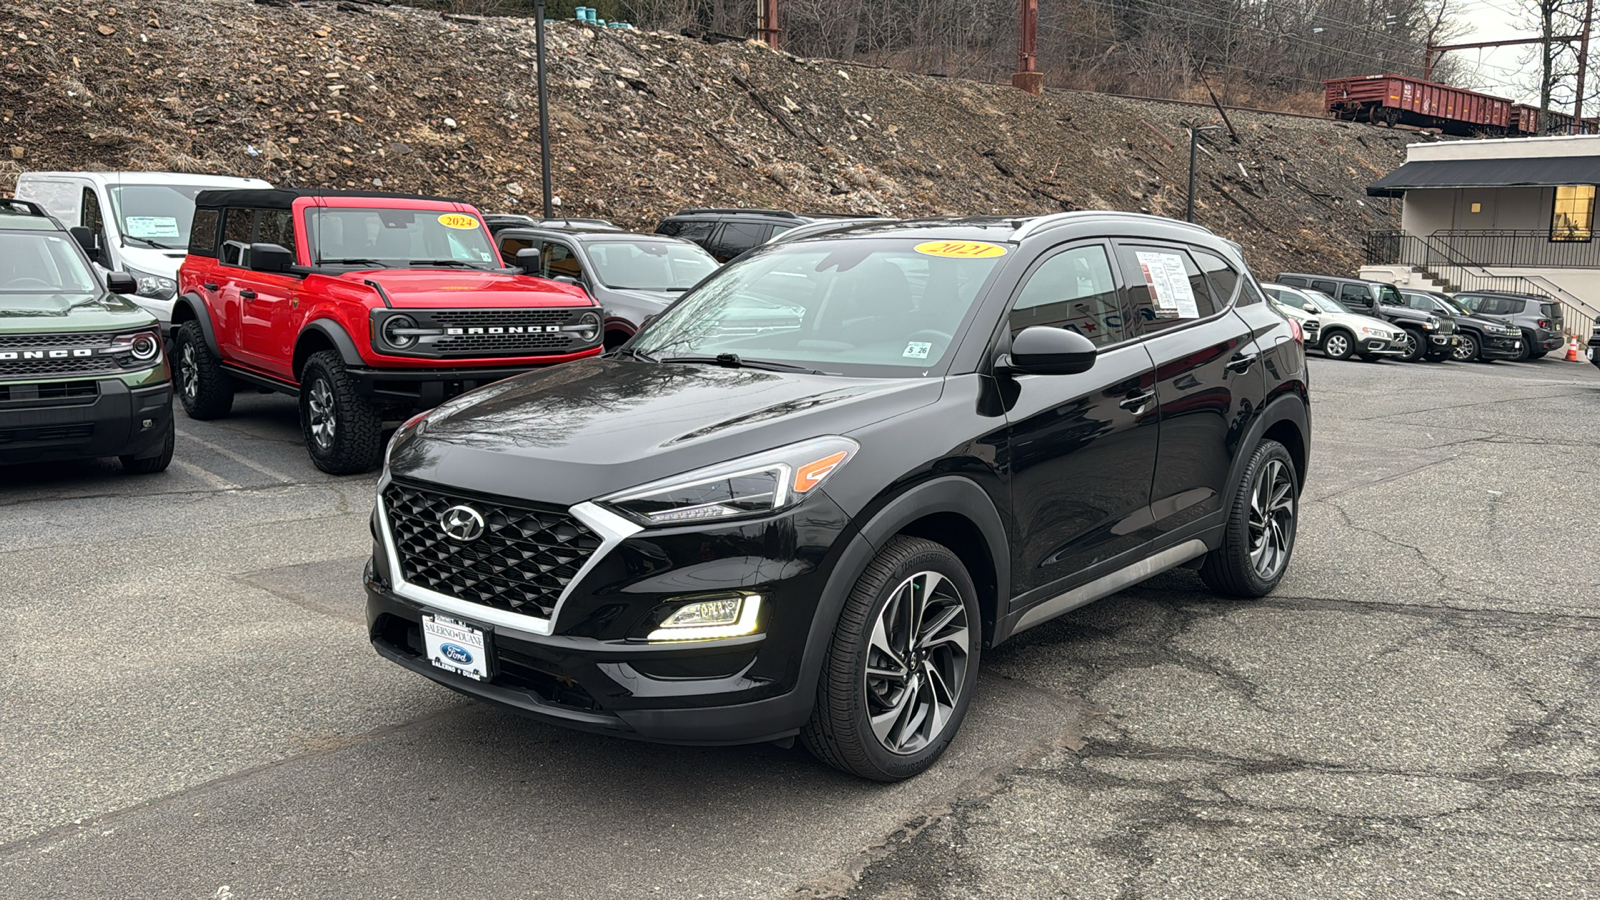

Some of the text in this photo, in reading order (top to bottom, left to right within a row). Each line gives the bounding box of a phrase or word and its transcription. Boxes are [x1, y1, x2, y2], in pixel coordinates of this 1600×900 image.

[446, 217, 472, 226] 2024
[926, 243, 995, 255] 2021
[447, 325, 560, 335] BRONCO
[901, 552, 951, 575] BRIDGESTONE
[425, 622, 483, 646] SALERNO DUANE
[446, 645, 467, 662] Ford
